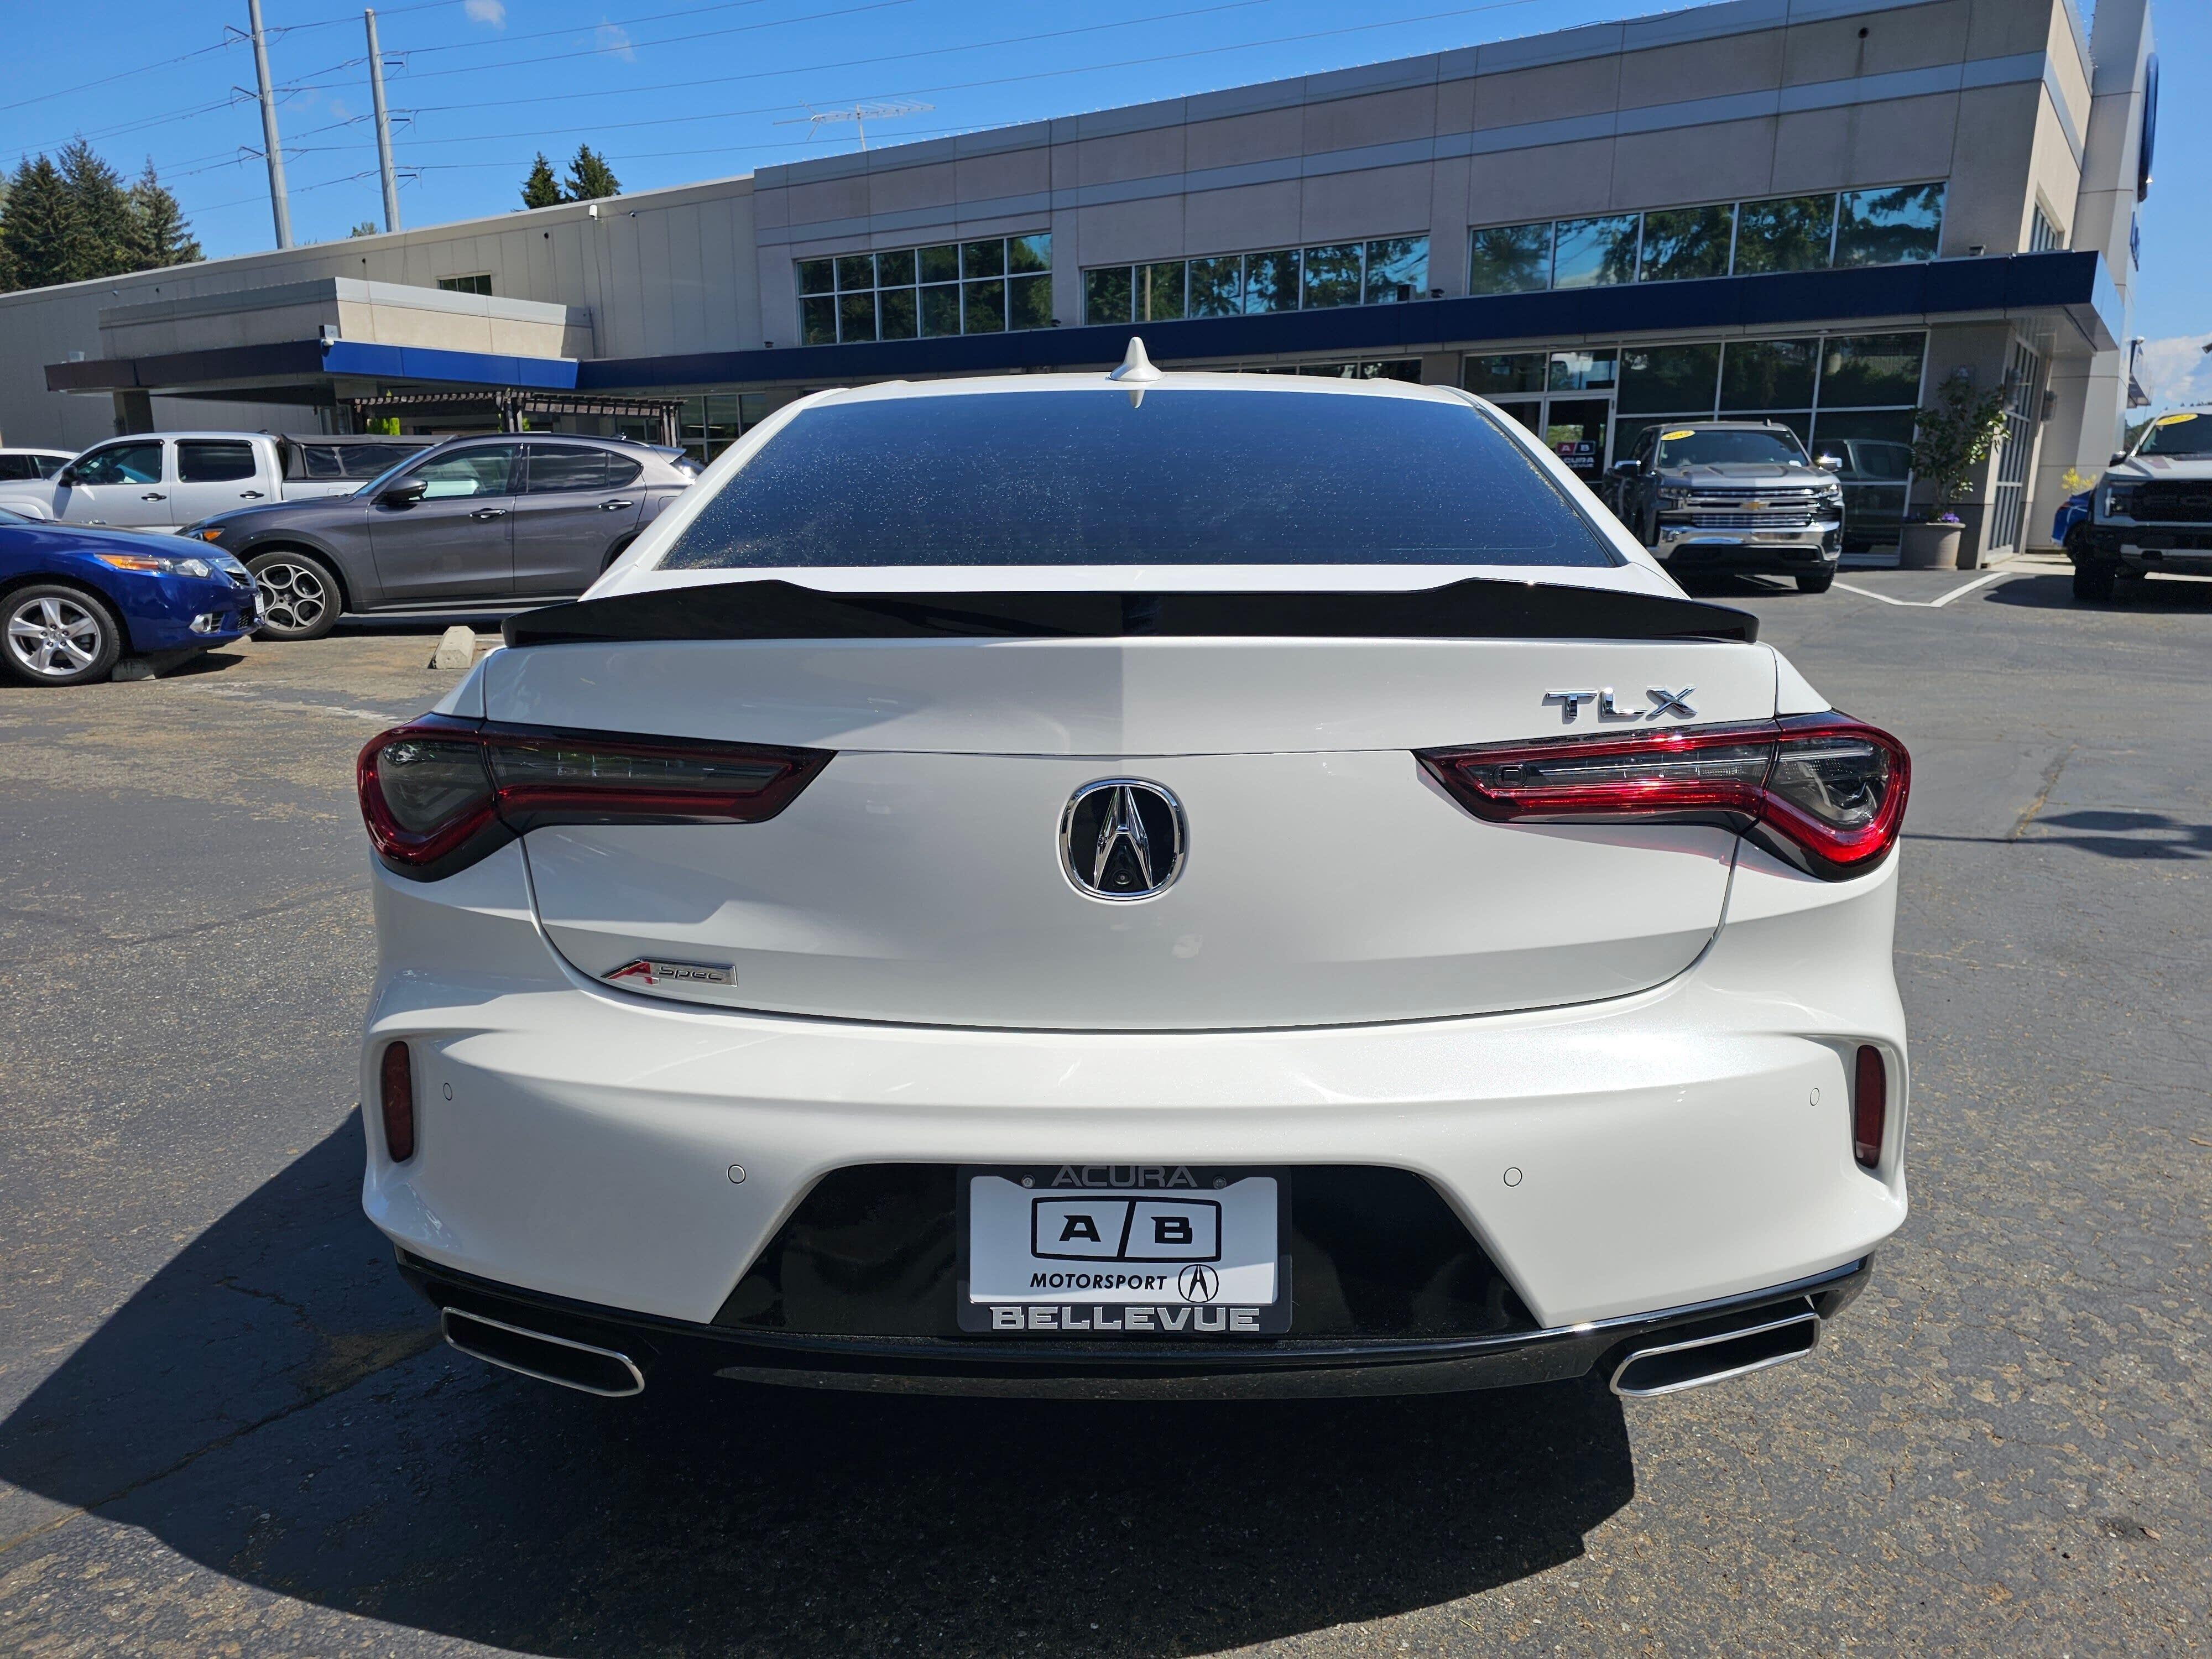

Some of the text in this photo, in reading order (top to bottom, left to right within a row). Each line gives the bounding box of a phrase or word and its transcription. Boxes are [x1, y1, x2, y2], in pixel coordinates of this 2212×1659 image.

[1545, 687, 1698, 718] TLX
[1051, 1166, 1198, 1187] ACURA
[1059, 1215, 1193, 1244] A B
[1030, 1273, 1167, 1290] MOTORSPORT
[989, 1307, 1260, 1331] BELLEVUE
